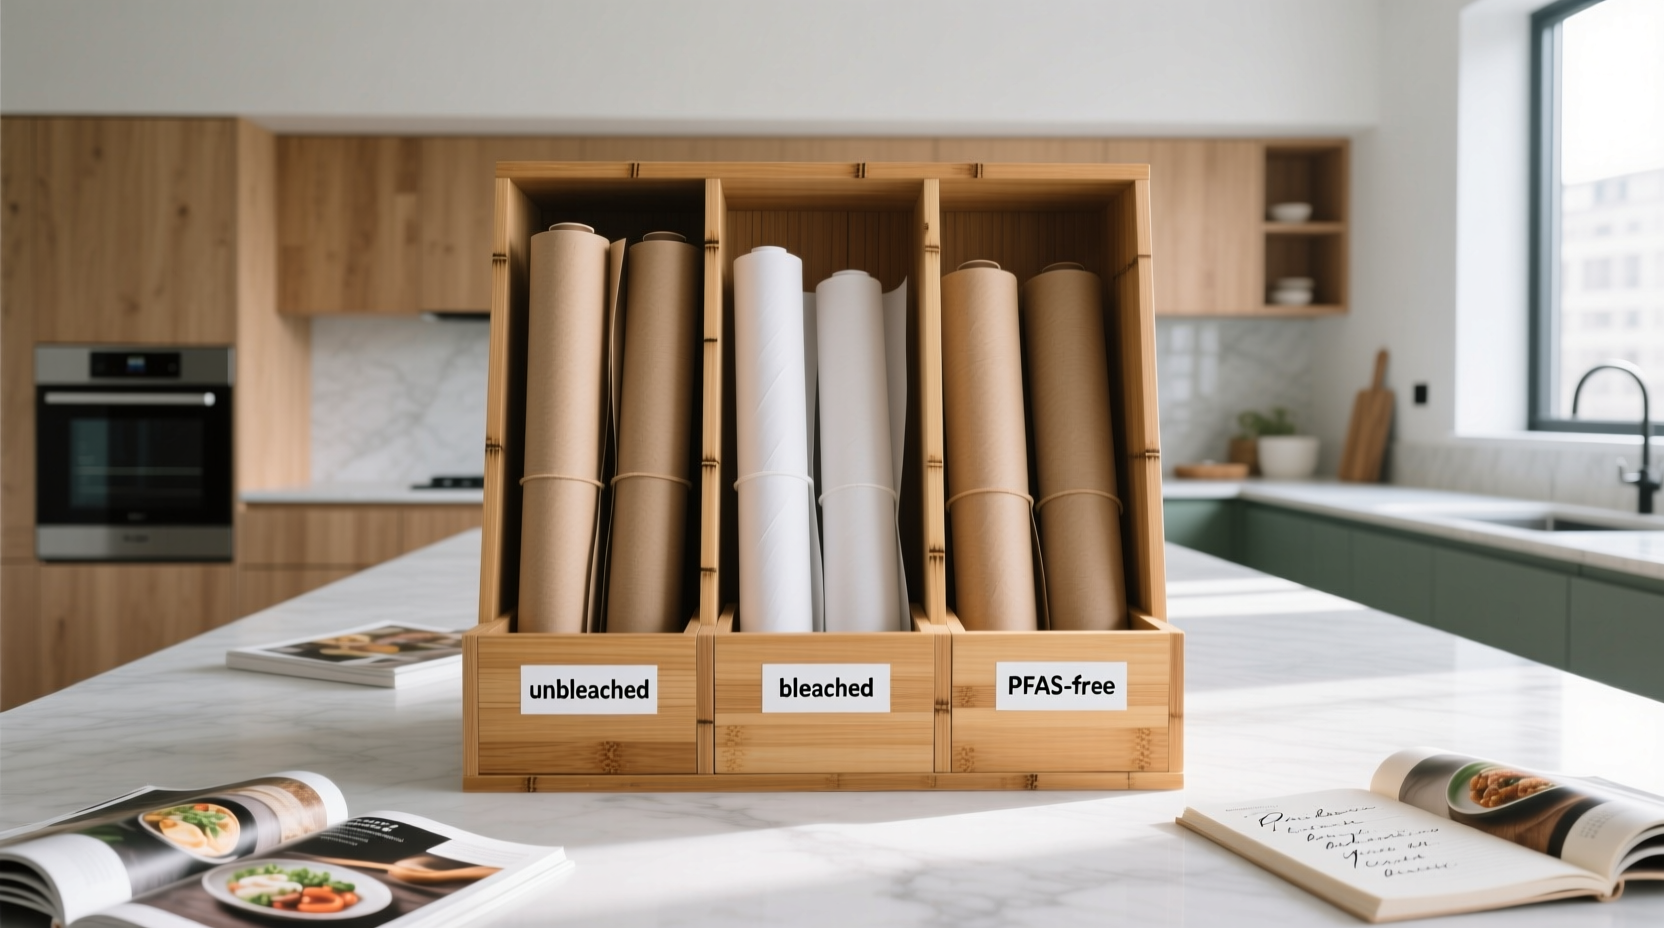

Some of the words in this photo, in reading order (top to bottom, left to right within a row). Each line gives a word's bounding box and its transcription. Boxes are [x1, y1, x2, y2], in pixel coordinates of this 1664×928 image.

[529, 678, 649, 700] unbleached
[779, 676, 874, 698] bleached
[1008, 674, 1116, 696] PFAS-free
